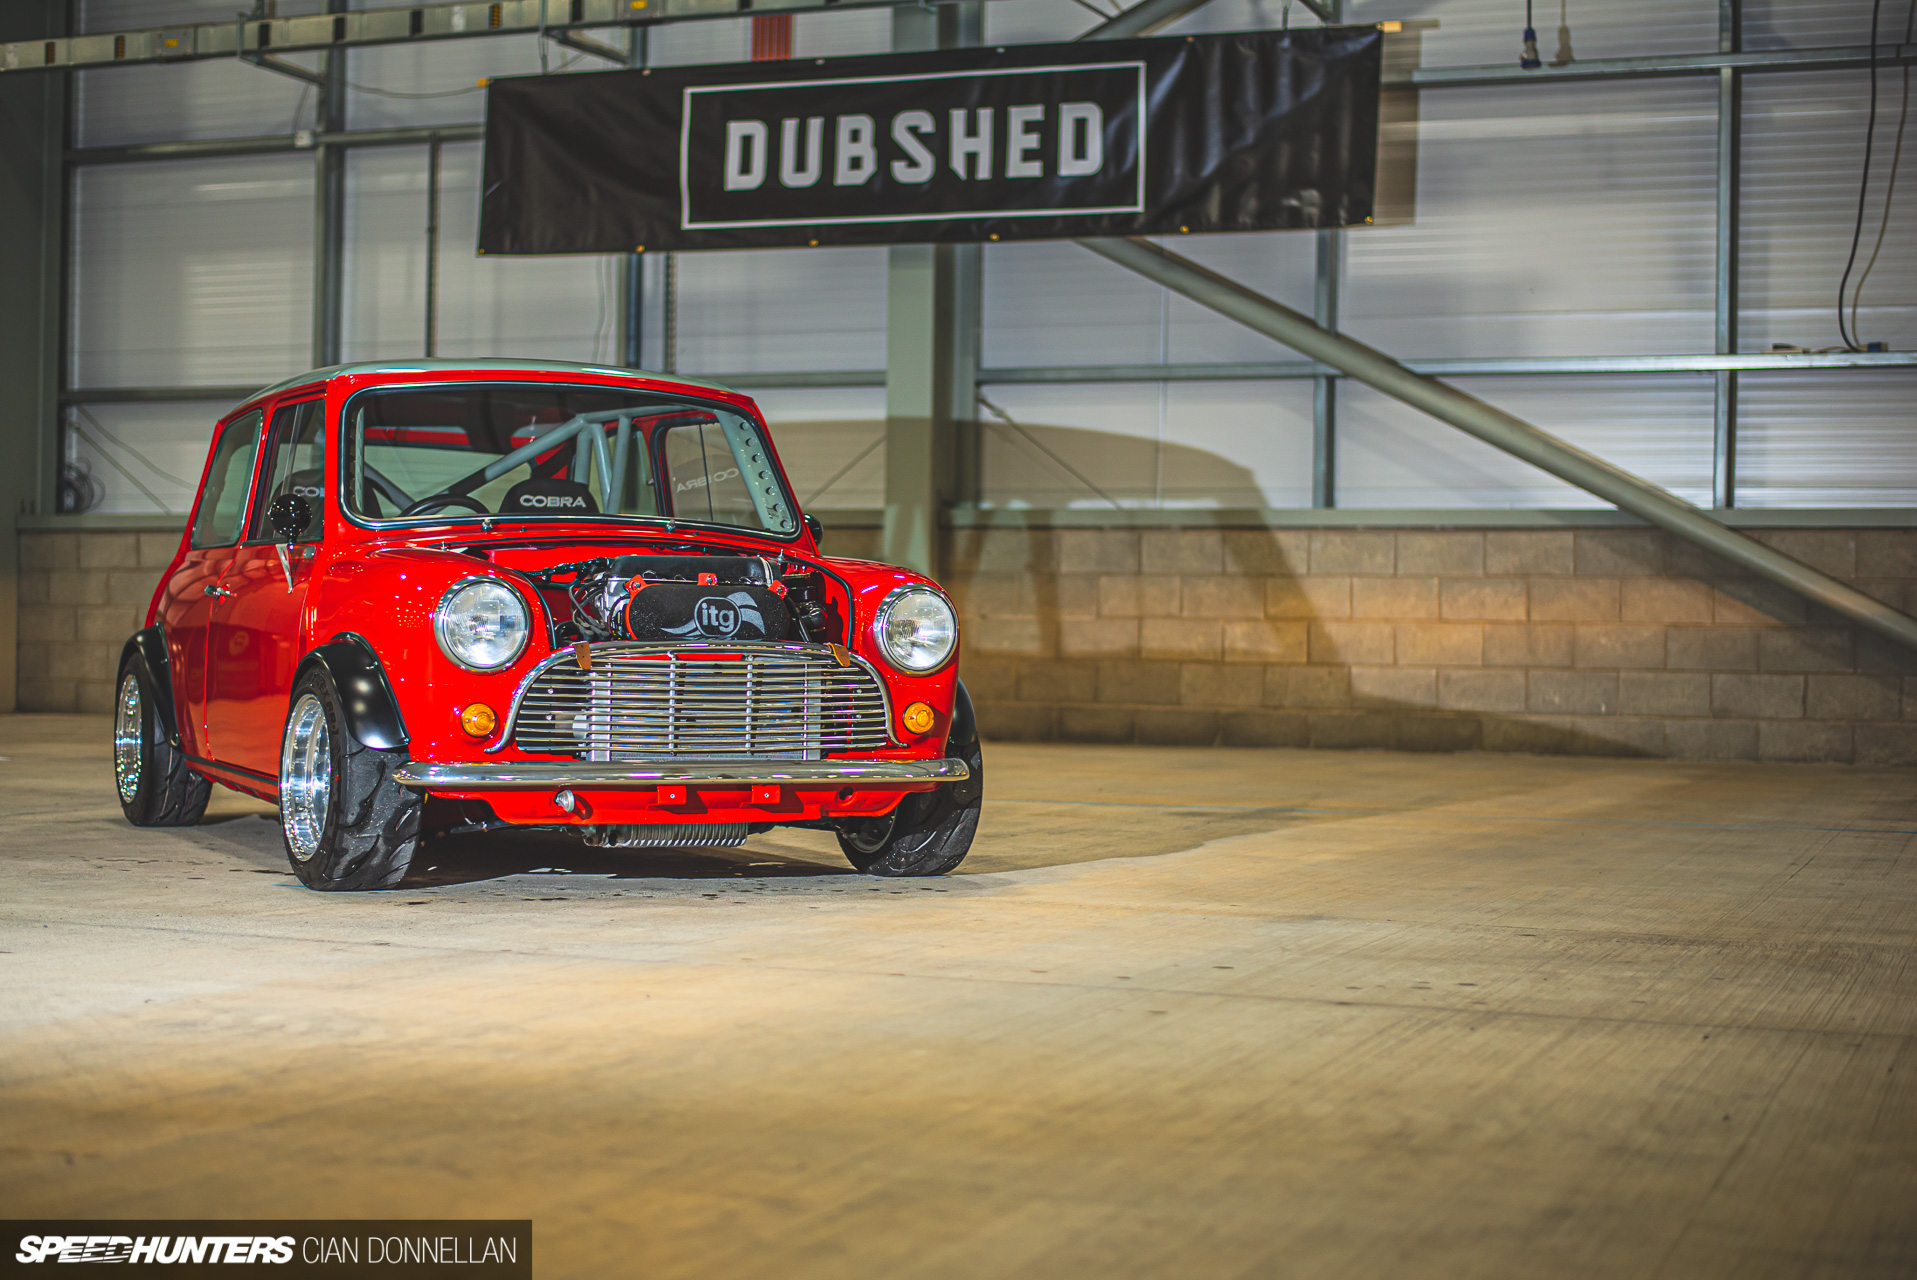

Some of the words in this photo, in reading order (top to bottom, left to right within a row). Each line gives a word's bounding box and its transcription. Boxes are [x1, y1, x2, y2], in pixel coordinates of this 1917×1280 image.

[724, 101, 1104, 192] DUBSHED
[520, 495, 586, 508] COBRA
[702, 602, 735, 632] itg
